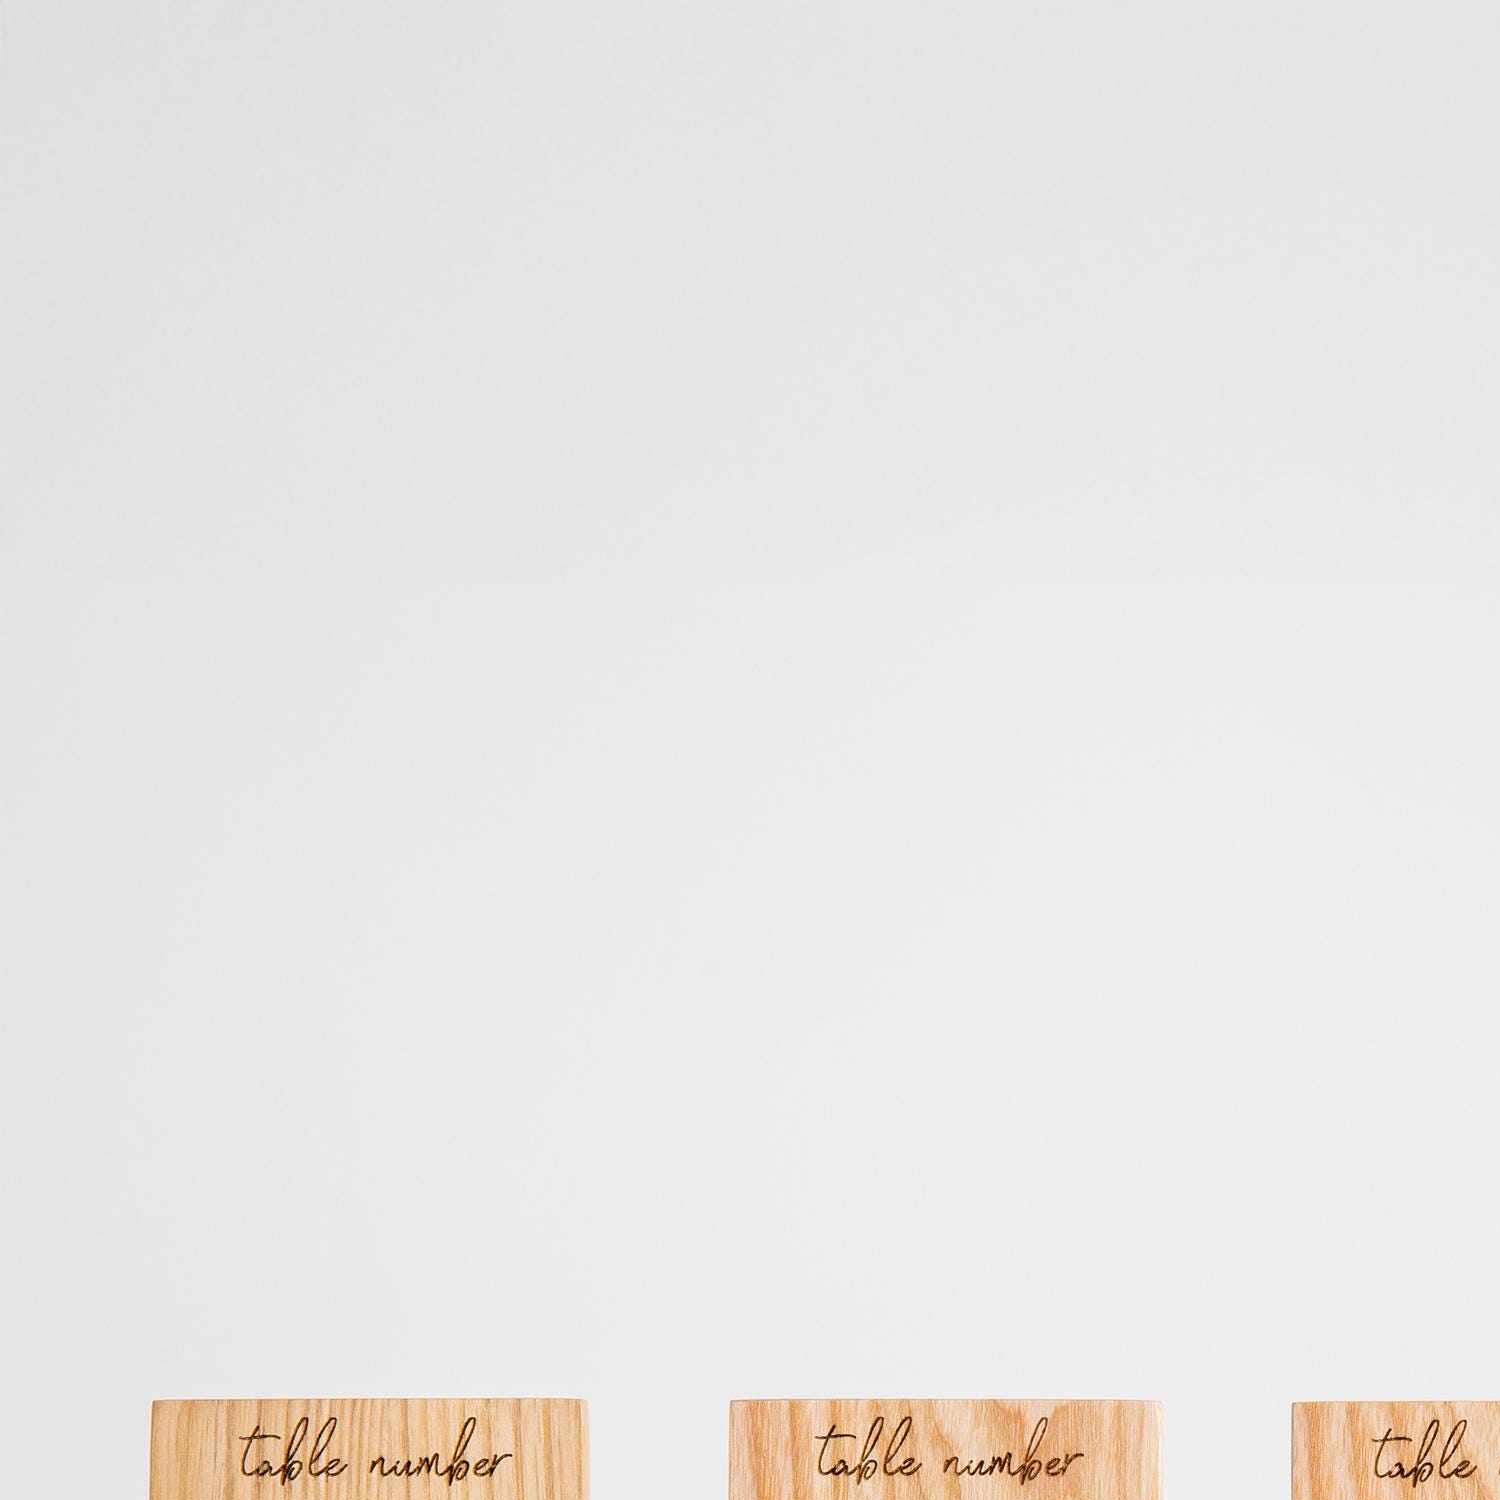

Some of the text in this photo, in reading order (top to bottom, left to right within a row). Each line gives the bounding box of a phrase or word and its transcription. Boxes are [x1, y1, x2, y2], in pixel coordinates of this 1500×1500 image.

[239, 1416, 513, 1487] table number
[815, 1416, 1085, 1486] table number
[1374, 1418, 1478, 1489] table
